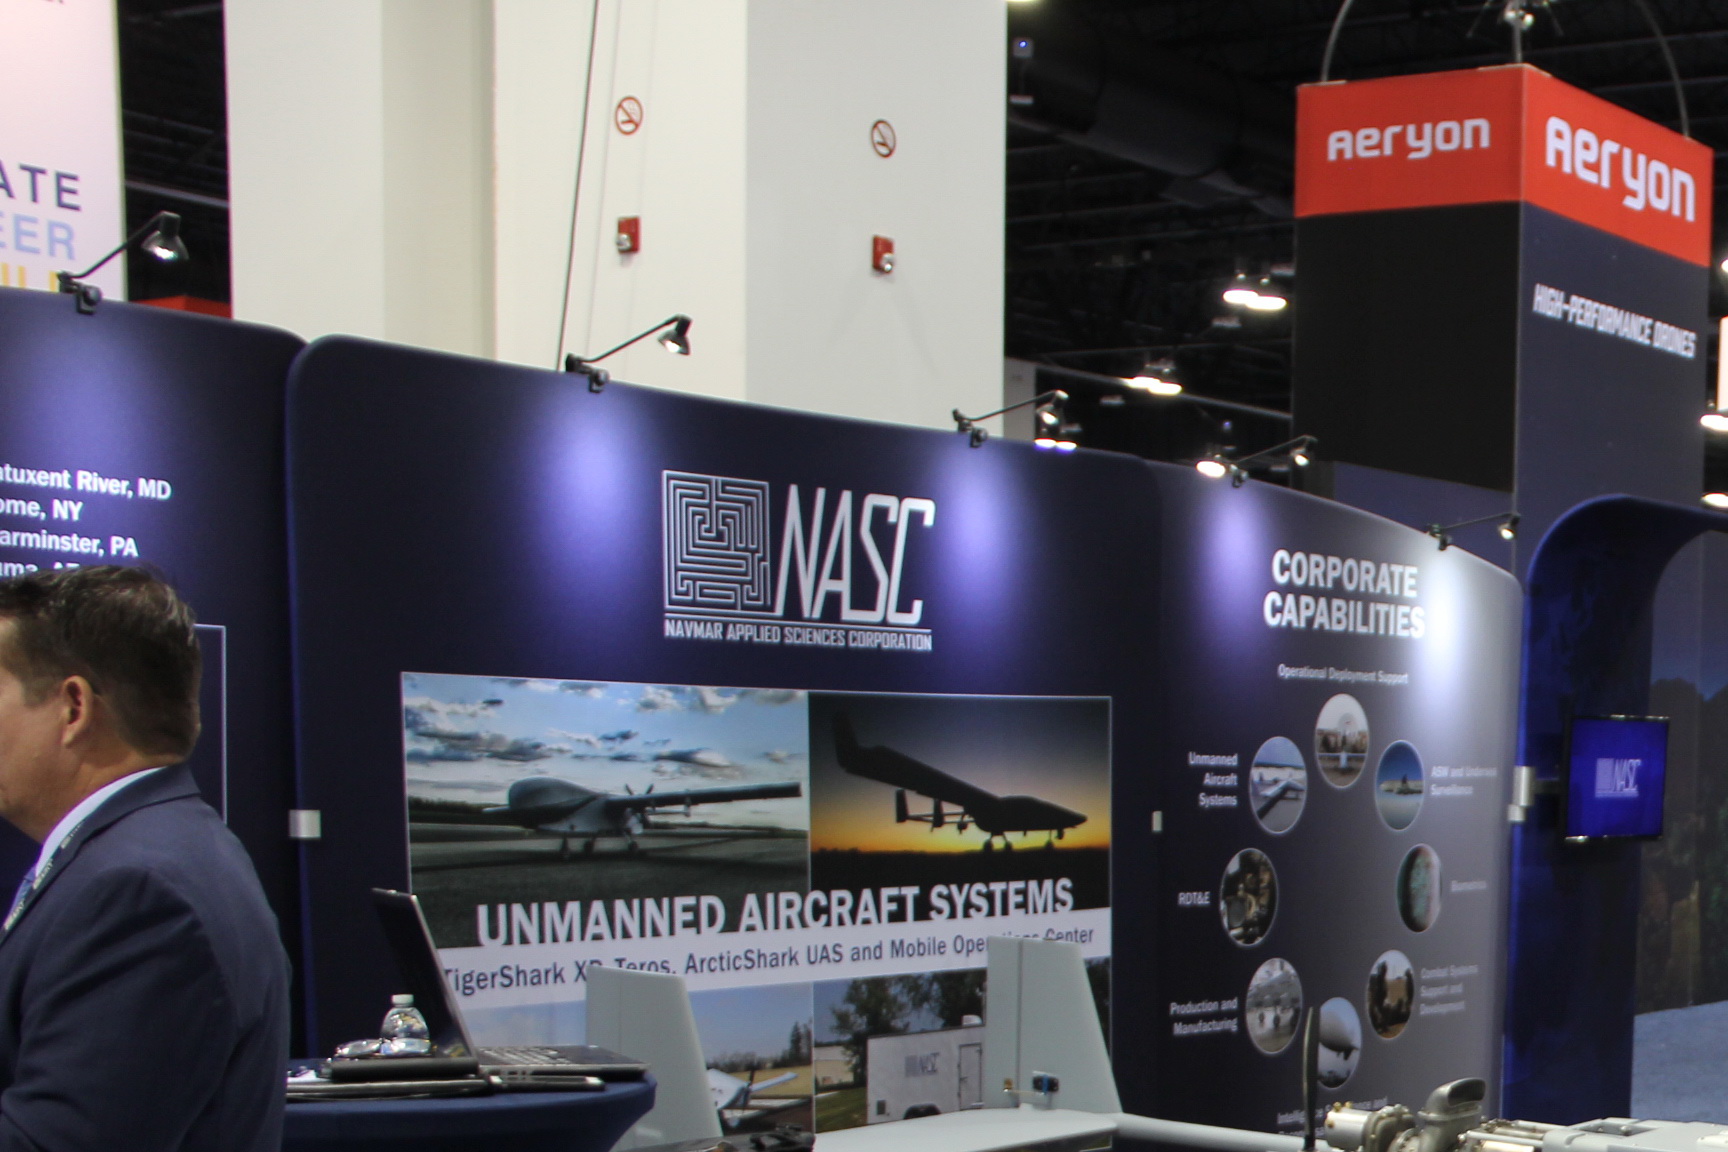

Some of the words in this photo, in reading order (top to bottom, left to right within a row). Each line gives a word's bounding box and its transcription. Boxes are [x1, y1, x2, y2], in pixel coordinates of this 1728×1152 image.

[1532, 282, 1654, 346] HIGH-PERFORMANCE
[1653, 320, 1697, 358] DRONES
[76, 469, 134, 499] River,
[137, 477, 172, 500] MD
[52, 498, 83, 521] NY
[110, 535, 139, 557] PA
[774, 483, 936, 626] NASC
[1272, 549, 1418, 597] CORPORATE
[1263, 591, 1426, 638] CAPABILITIES
[664, 619, 723, 641] NAVMAR
[726, 622, 781, 644] APPLIED
[784, 629, 846, 648] SCIENCES
[848, 633, 932, 651] CORPORATION
[1277, 664, 1327, 680] Operational
[1188, 752, 1239, 766] Unmanned
[1203, 772, 1238, 786] Aircraft
[1199, 792, 1238, 808] Systems
[476, 895, 726, 947] UNMANNED
[738, 885, 921, 935] AIRCRAFT
[929, 877, 1075, 921] SYSTEMS
[444, 961, 566, 997] TigerShark
[685, 945, 800, 975] ArcticShark
[807, 943, 844, 966] UAS
[851, 939, 884, 962] and
[890, 938, 947, 960] Mobile
[1170, 1000, 1218, 1016] Production
[1220, 997, 1238, 1010] and
[1173, 1017, 1238, 1036] Manufacturing
